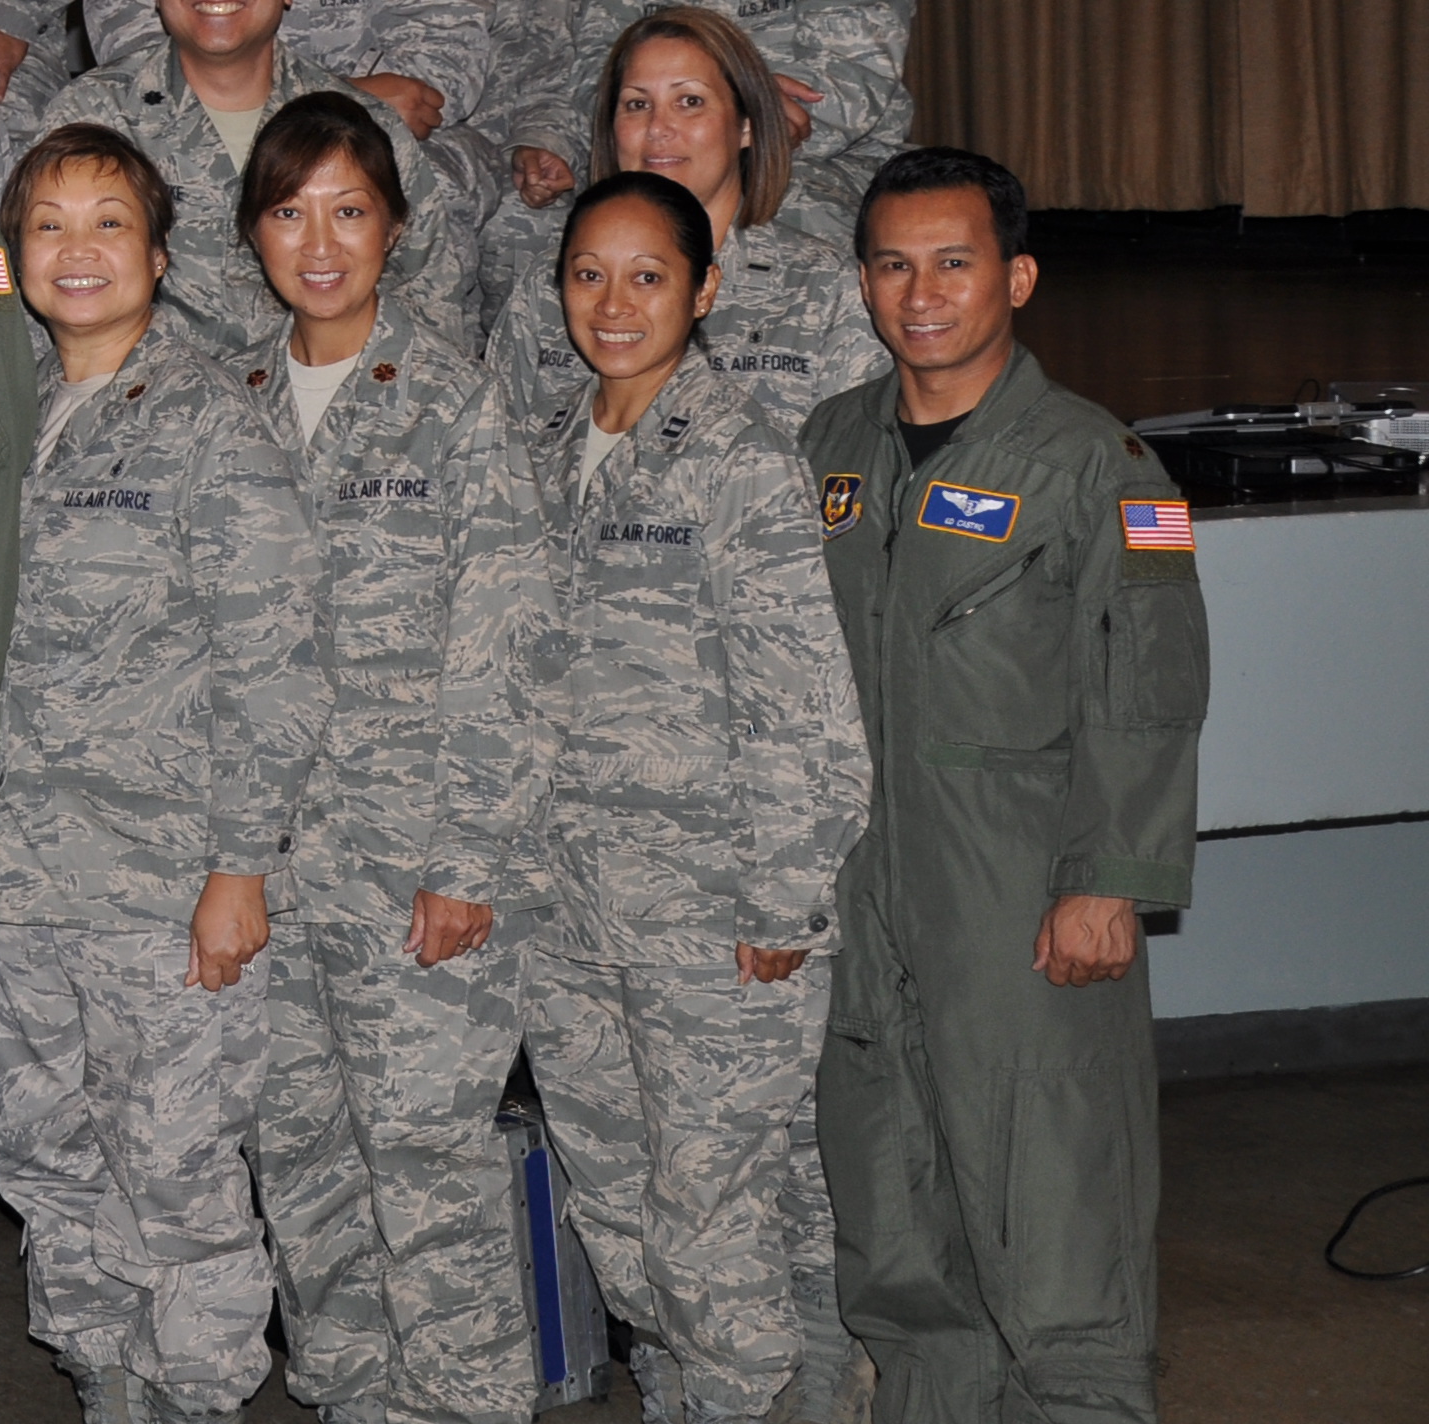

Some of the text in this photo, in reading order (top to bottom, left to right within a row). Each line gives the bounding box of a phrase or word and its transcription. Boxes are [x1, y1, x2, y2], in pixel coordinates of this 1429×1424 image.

[738, 2, 760, 18] U.S.
[731, 355, 758, 373] AIR
[761, 353, 811, 375] FORCE
[62, 489, 152, 512] U.S. AIR FORCE
[338, 478, 430, 502] U.S. AIR FORCE
[600, 523, 692, 547] U.S. AIR FORCE
